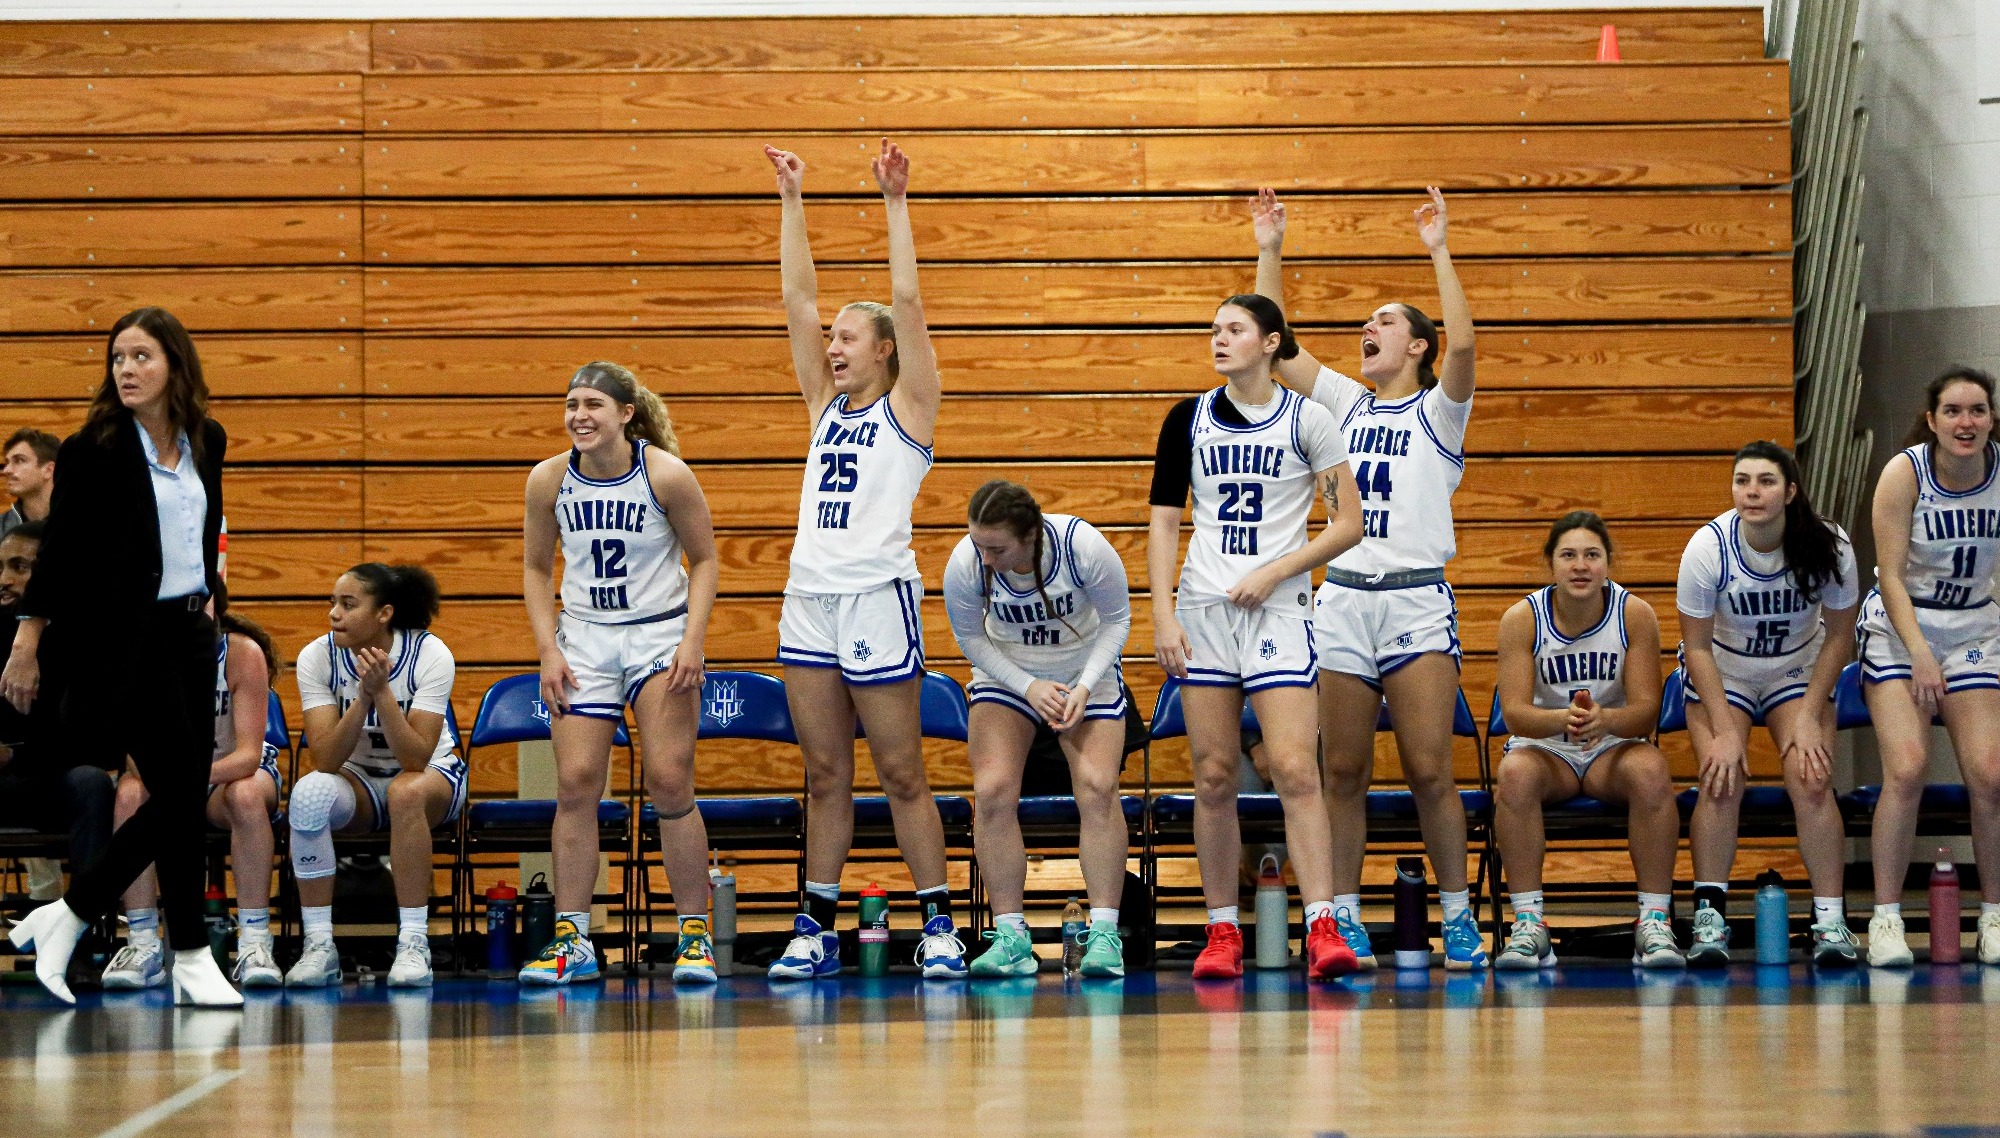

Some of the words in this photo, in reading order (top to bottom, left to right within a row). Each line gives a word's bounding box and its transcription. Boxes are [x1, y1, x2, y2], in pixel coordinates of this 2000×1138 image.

[818, 453, 858, 492] 25
[1199, 445, 1284, 478] LAWRENCE
[1355, 461, 1392, 501] 44
[563, 500, 647, 533] LAWRENCE
[817, 501, 851, 529] TECH
[1218, 483, 1263, 522] 23
[1362, 509, 1390, 538] ECH
[1222, 525, 1258, 555] TECH
[591, 539, 627, 578] 12
[1952, 546, 1977, 578] 11
[590, 585, 629, 610] TECH
[1934, 580, 1972, 606] TECH
[1540, 652, 1617, 684] LAWRENCE
